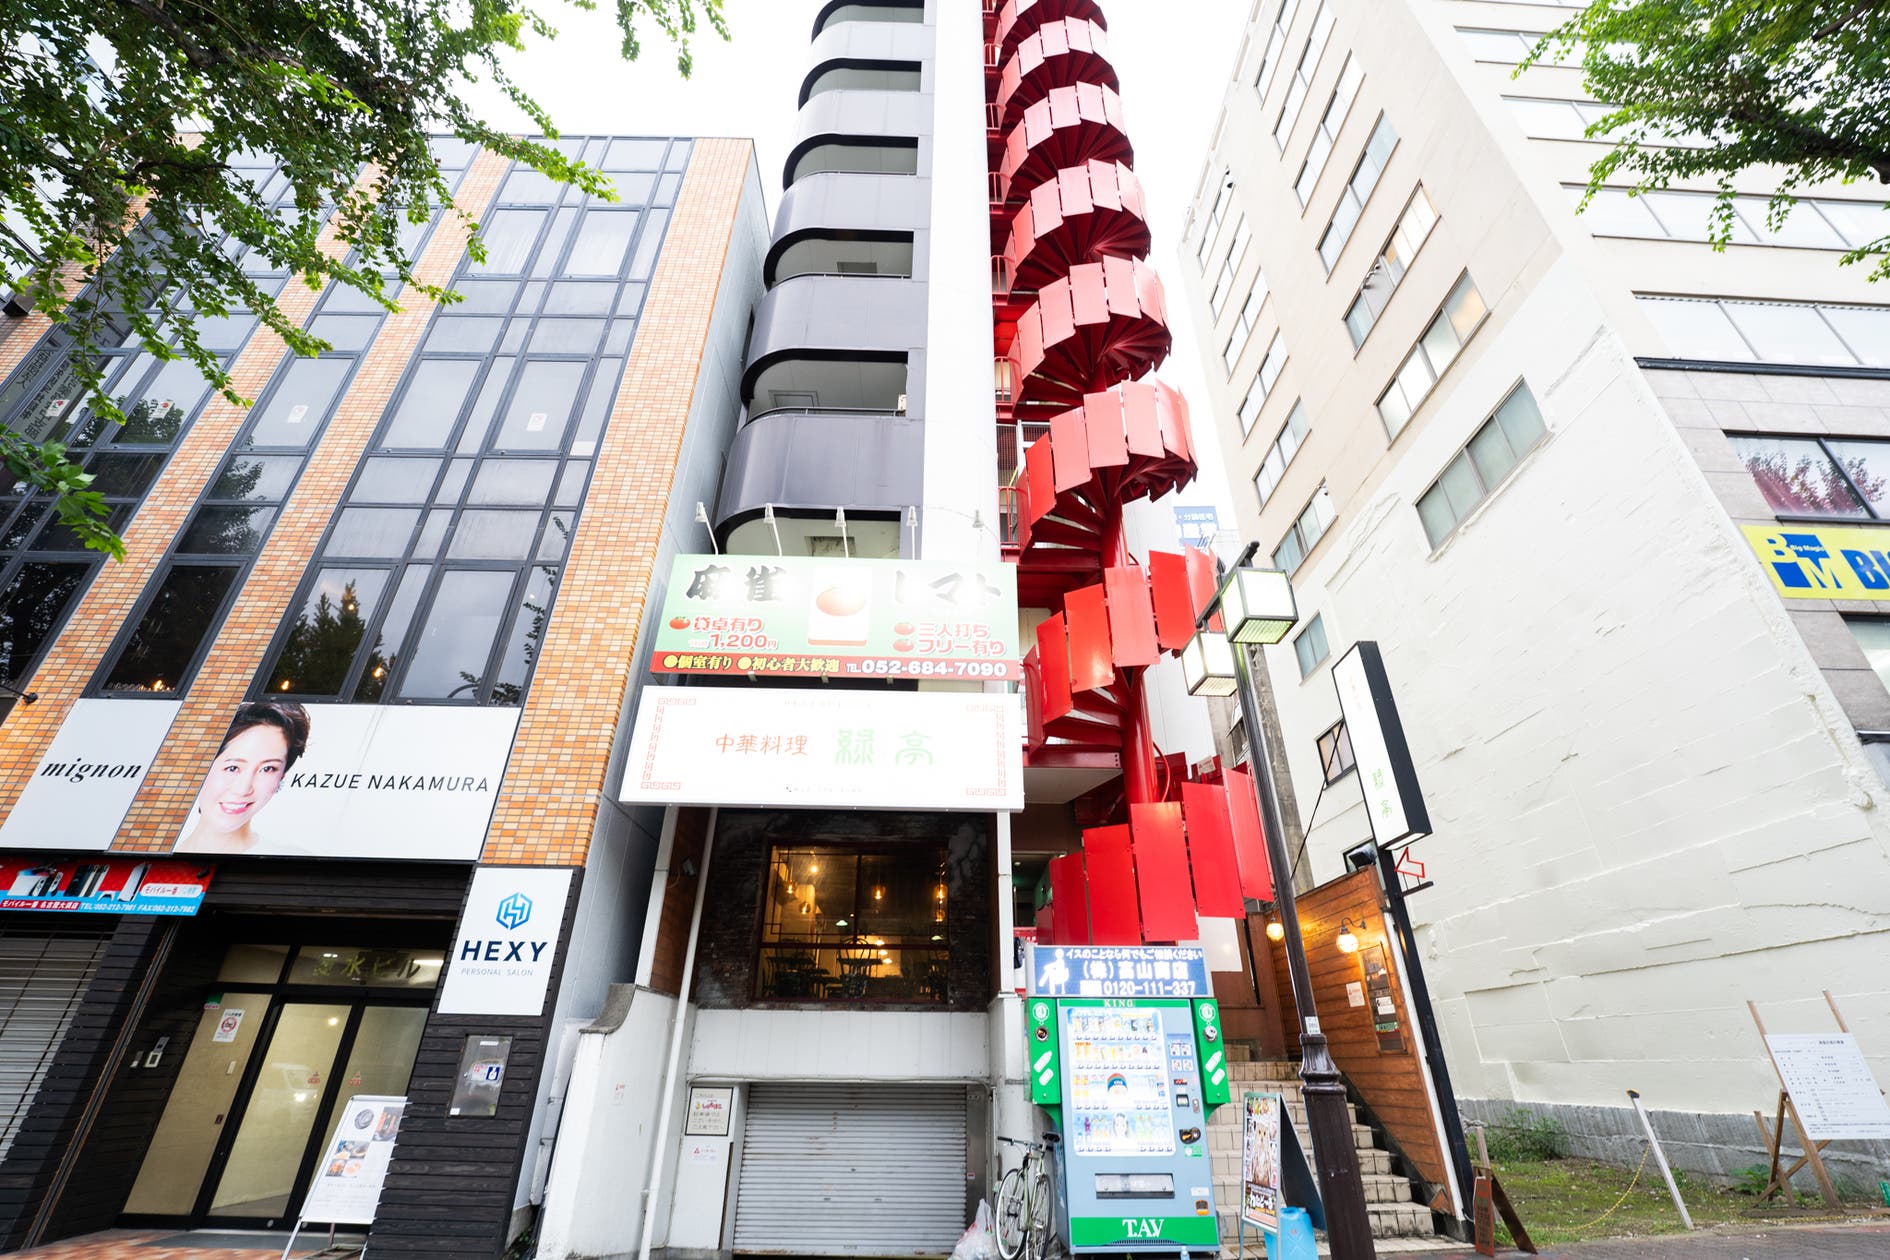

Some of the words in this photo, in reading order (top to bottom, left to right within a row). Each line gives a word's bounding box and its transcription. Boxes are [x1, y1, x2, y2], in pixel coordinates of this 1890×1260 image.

[1841, 549, 1890, 590] BI
[918, 622, 990, 638] 三人打ち
[918, 639, 1006, 655] フリー有り
[861, 659, 1007, 677] 052-684-7090
[715, 733, 808, 756] 中華料理
[40, 757, 142, 784] mignon
[289, 772, 362, 789] KAZUE
[367, 773, 489, 792] NAKAMURA
[460, 940, 547, 962] HEXY
[461, 968, 501, 977] PERSONAL
[507, 968, 534, 977] SALON
[1104, 981, 1195, 996] 0120-111-337
